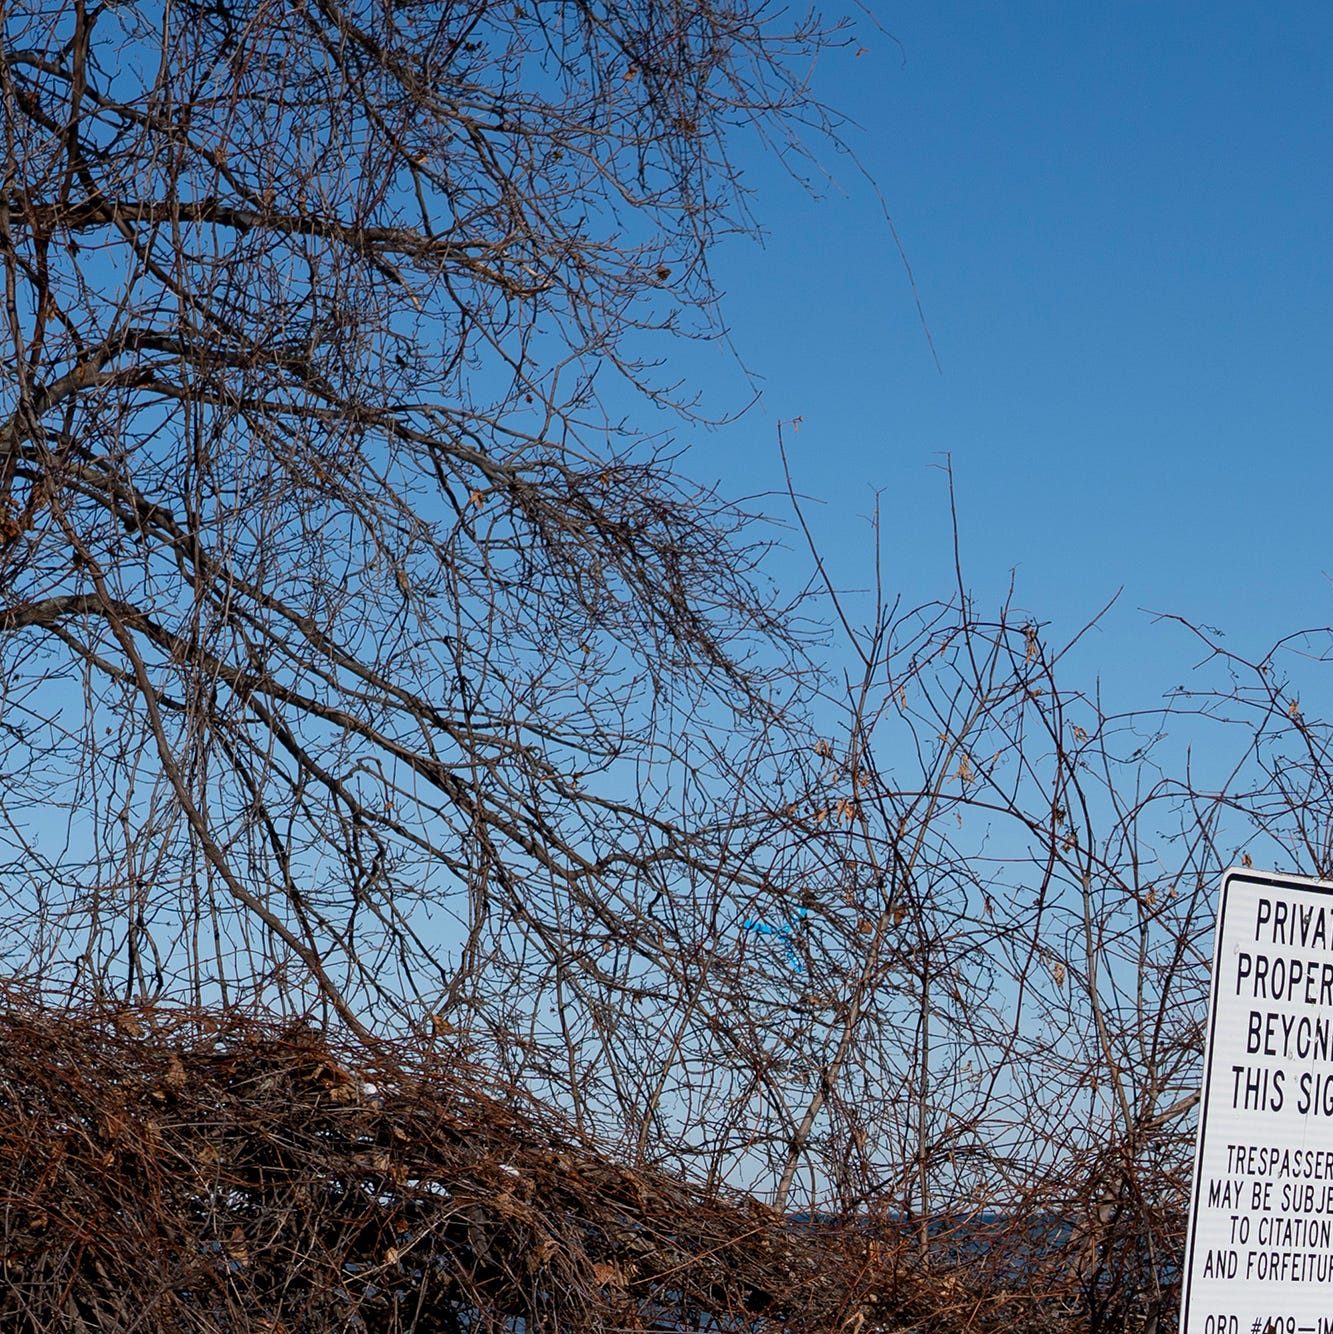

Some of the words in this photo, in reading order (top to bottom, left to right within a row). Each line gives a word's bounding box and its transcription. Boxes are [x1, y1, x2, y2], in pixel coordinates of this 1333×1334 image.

[1232, 1066, 1285, 1112] THIS
[1208, 1179, 1244, 1209] MAY
[1251, 1182, 1273, 1211] BE
[1230, 1216, 1250, 1245] TO
[1258, 1217, 1331, 1248] CITATION
[1203, 1250, 1238, 1279] AND
